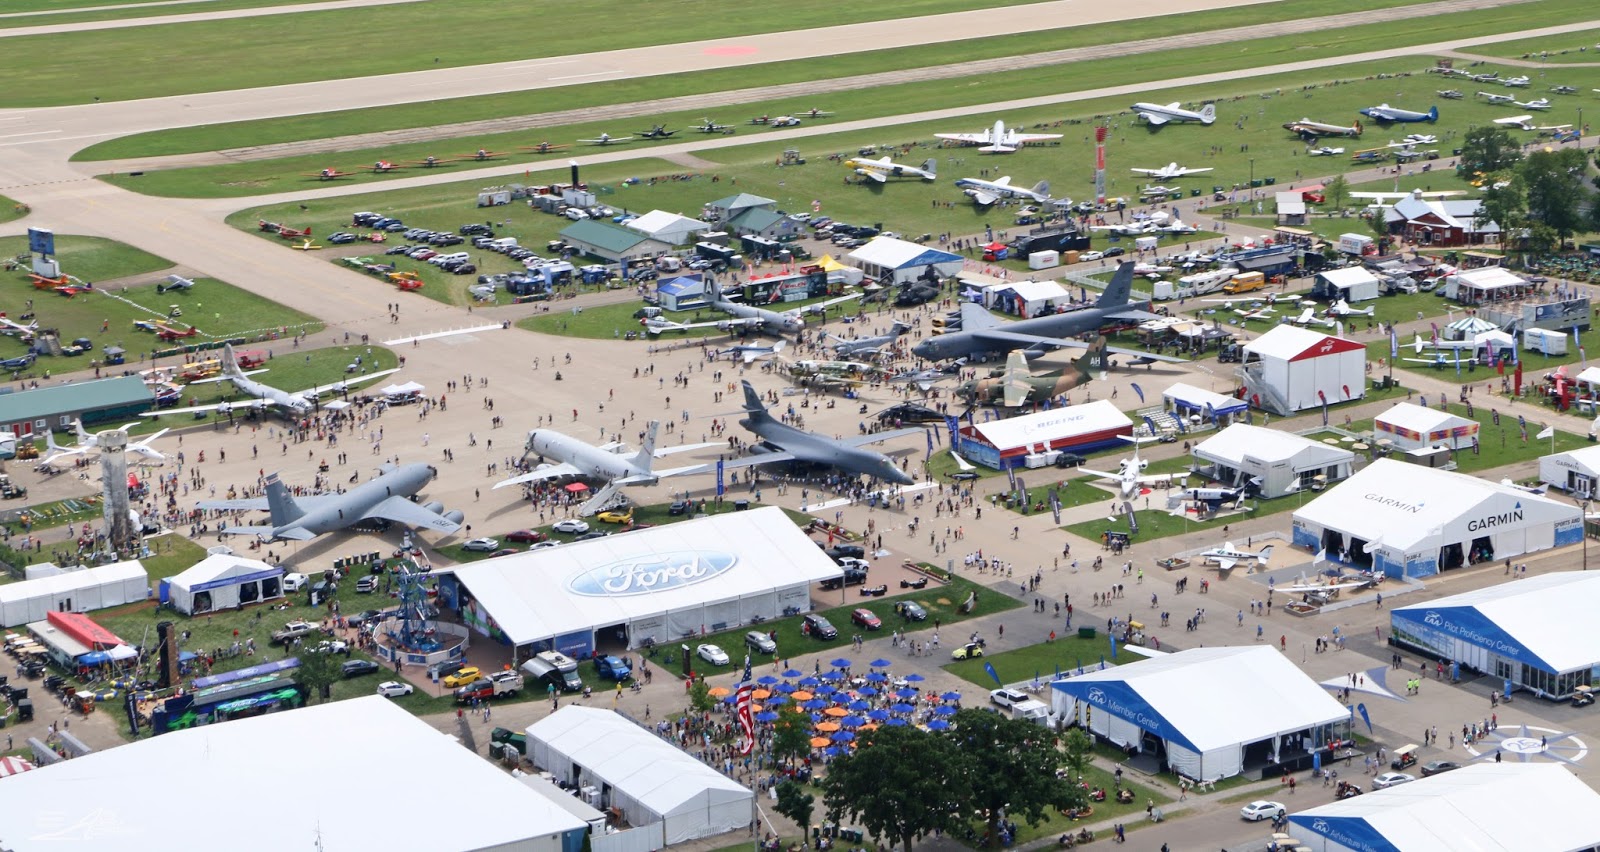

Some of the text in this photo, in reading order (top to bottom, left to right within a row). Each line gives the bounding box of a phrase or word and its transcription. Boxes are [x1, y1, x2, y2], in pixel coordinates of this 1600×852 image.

[705, 279, 713, 295] A
[1090, 356, 1101, 365] AH
[1037, 414, 1084, 429] BOEING
[1555, 459, 1580, 471] GARMIN
[1364, 493, 1421, 513] GARMIN
[1467, 509, 1523, 532] GARMIN
[1554, 519, 1571, 529] SPORTS
[604, 555, 707, 592] Ford
[1424, 616, 1520, 655] EAA Pilot Proficiency Center
[1088, 693, 1104, 704] EAA
[1107, 699, 1136, 720] Member
[1136, 713, 1160, 730] Center
[1312, 822, 1327, 833] EAA
